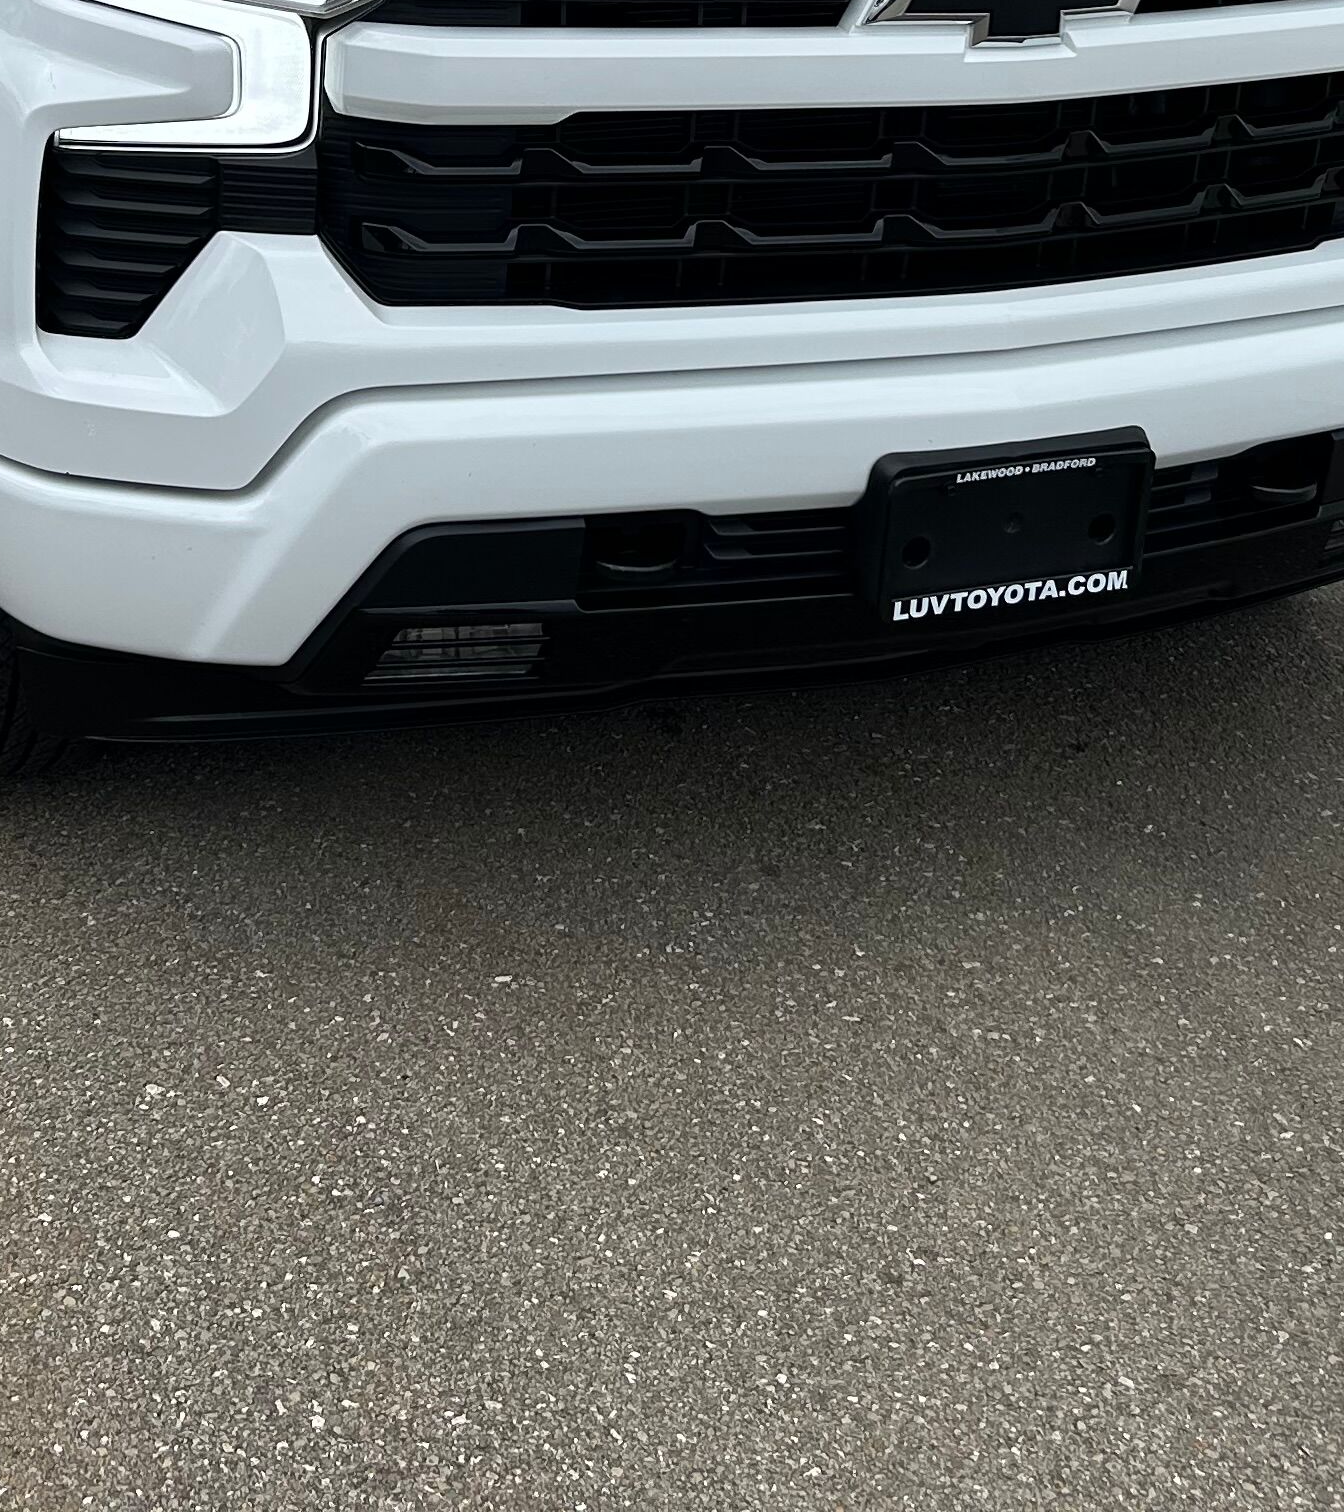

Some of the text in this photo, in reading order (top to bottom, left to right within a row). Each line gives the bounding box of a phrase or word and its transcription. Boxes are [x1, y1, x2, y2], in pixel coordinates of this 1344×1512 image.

[956, 457, 1097, 484] LAKEWOOD BRADFORD
[892, 569, 1129, 622] LUVTOYOTA.COM
